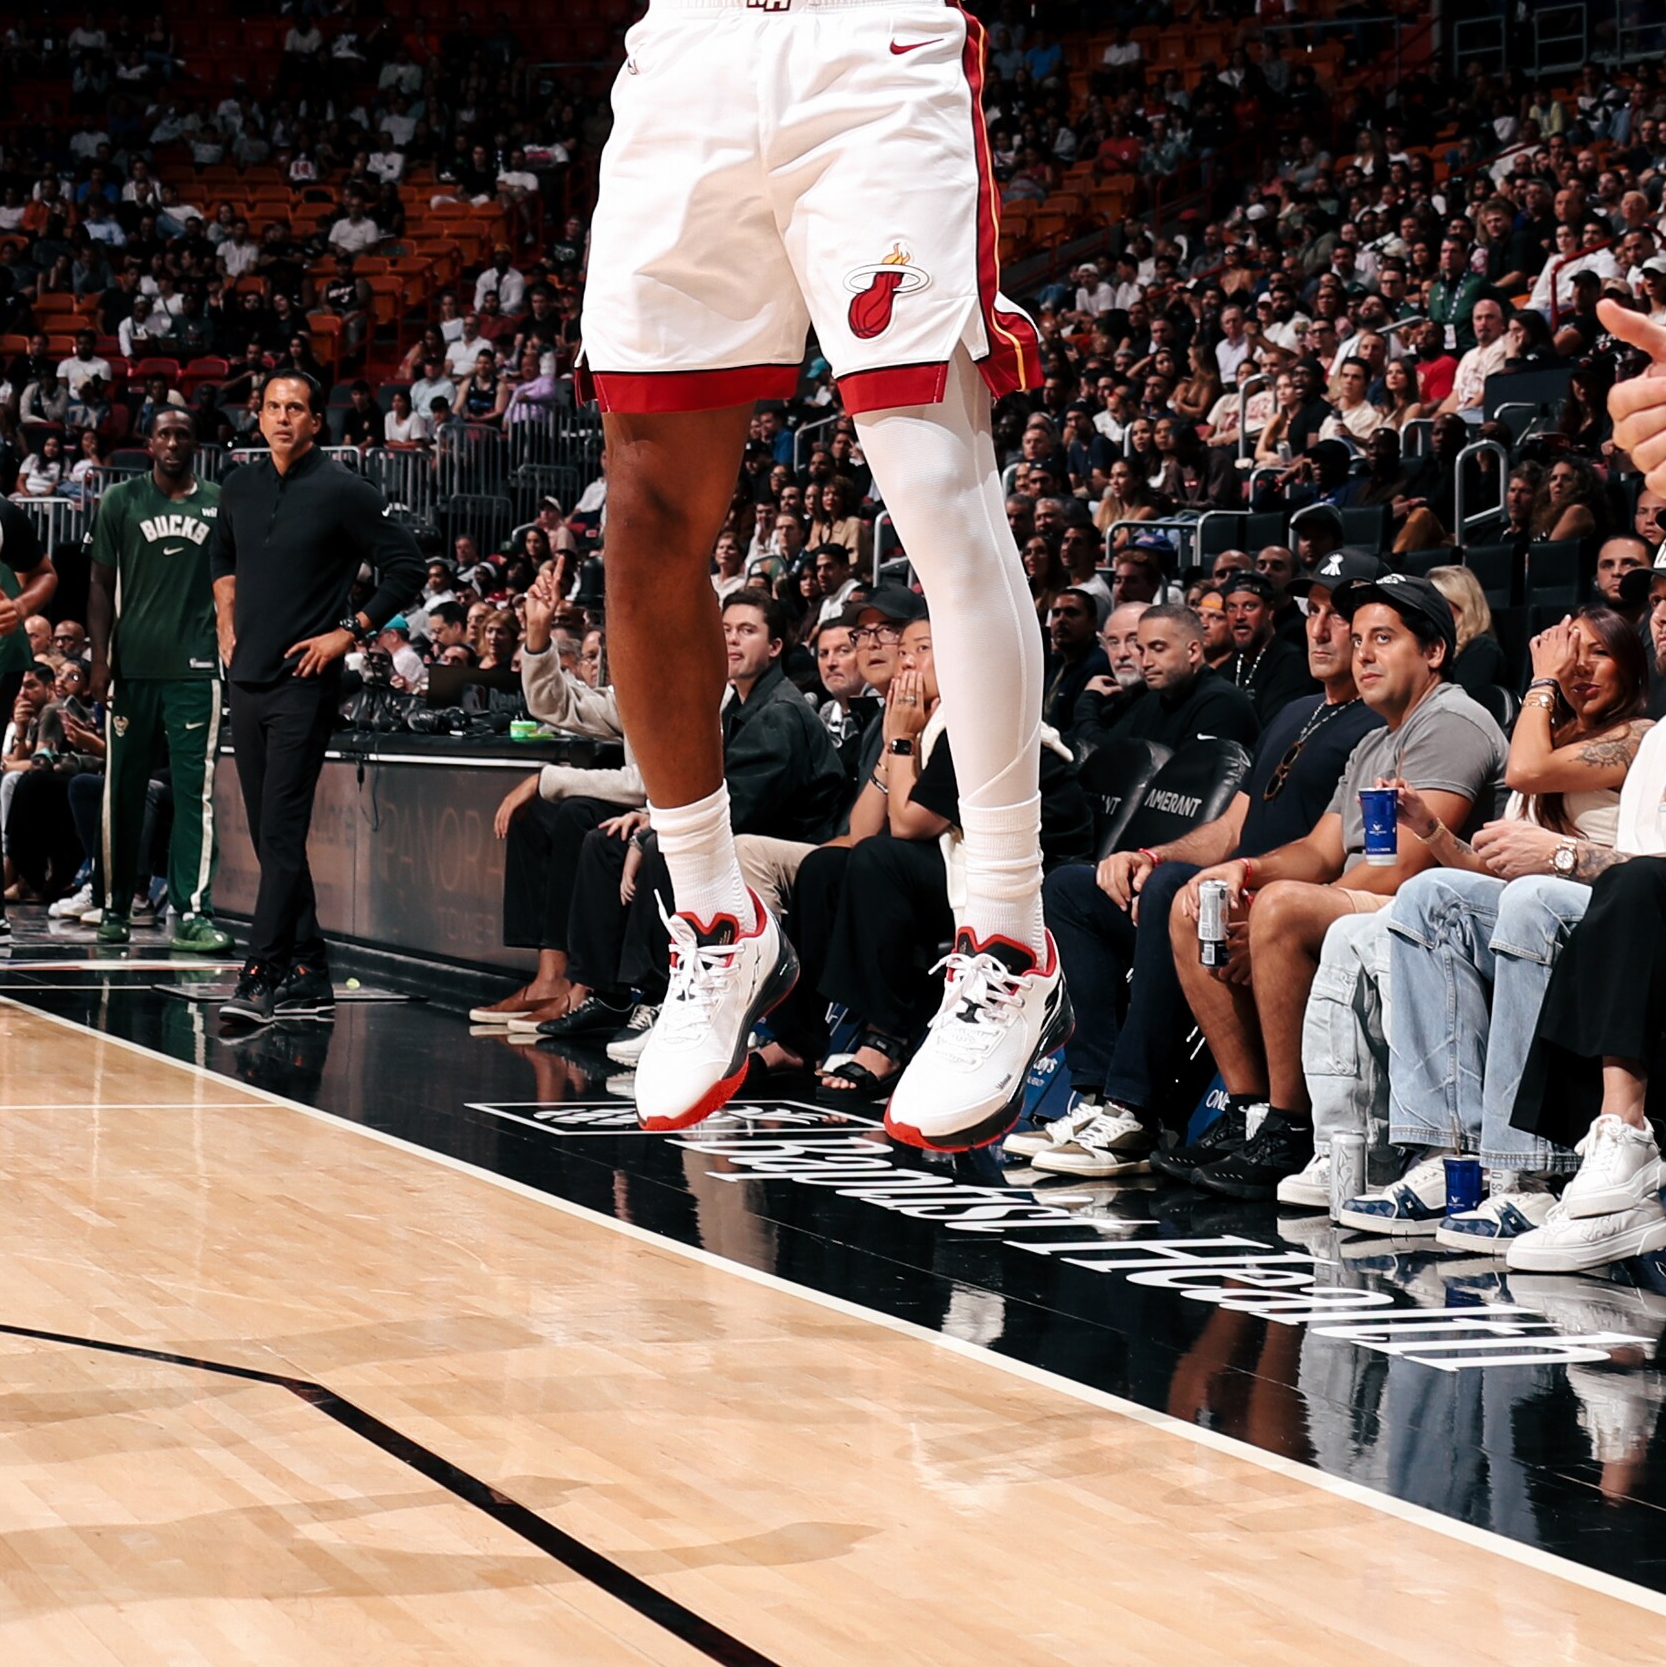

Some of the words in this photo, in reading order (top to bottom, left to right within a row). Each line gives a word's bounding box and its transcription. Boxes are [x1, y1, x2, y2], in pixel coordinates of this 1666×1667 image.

[139, 514, 211, 546] BUCKS
[1143, 788, 1203, 818] AMERANT
[1002, 1233, 1659, 1374] Health
